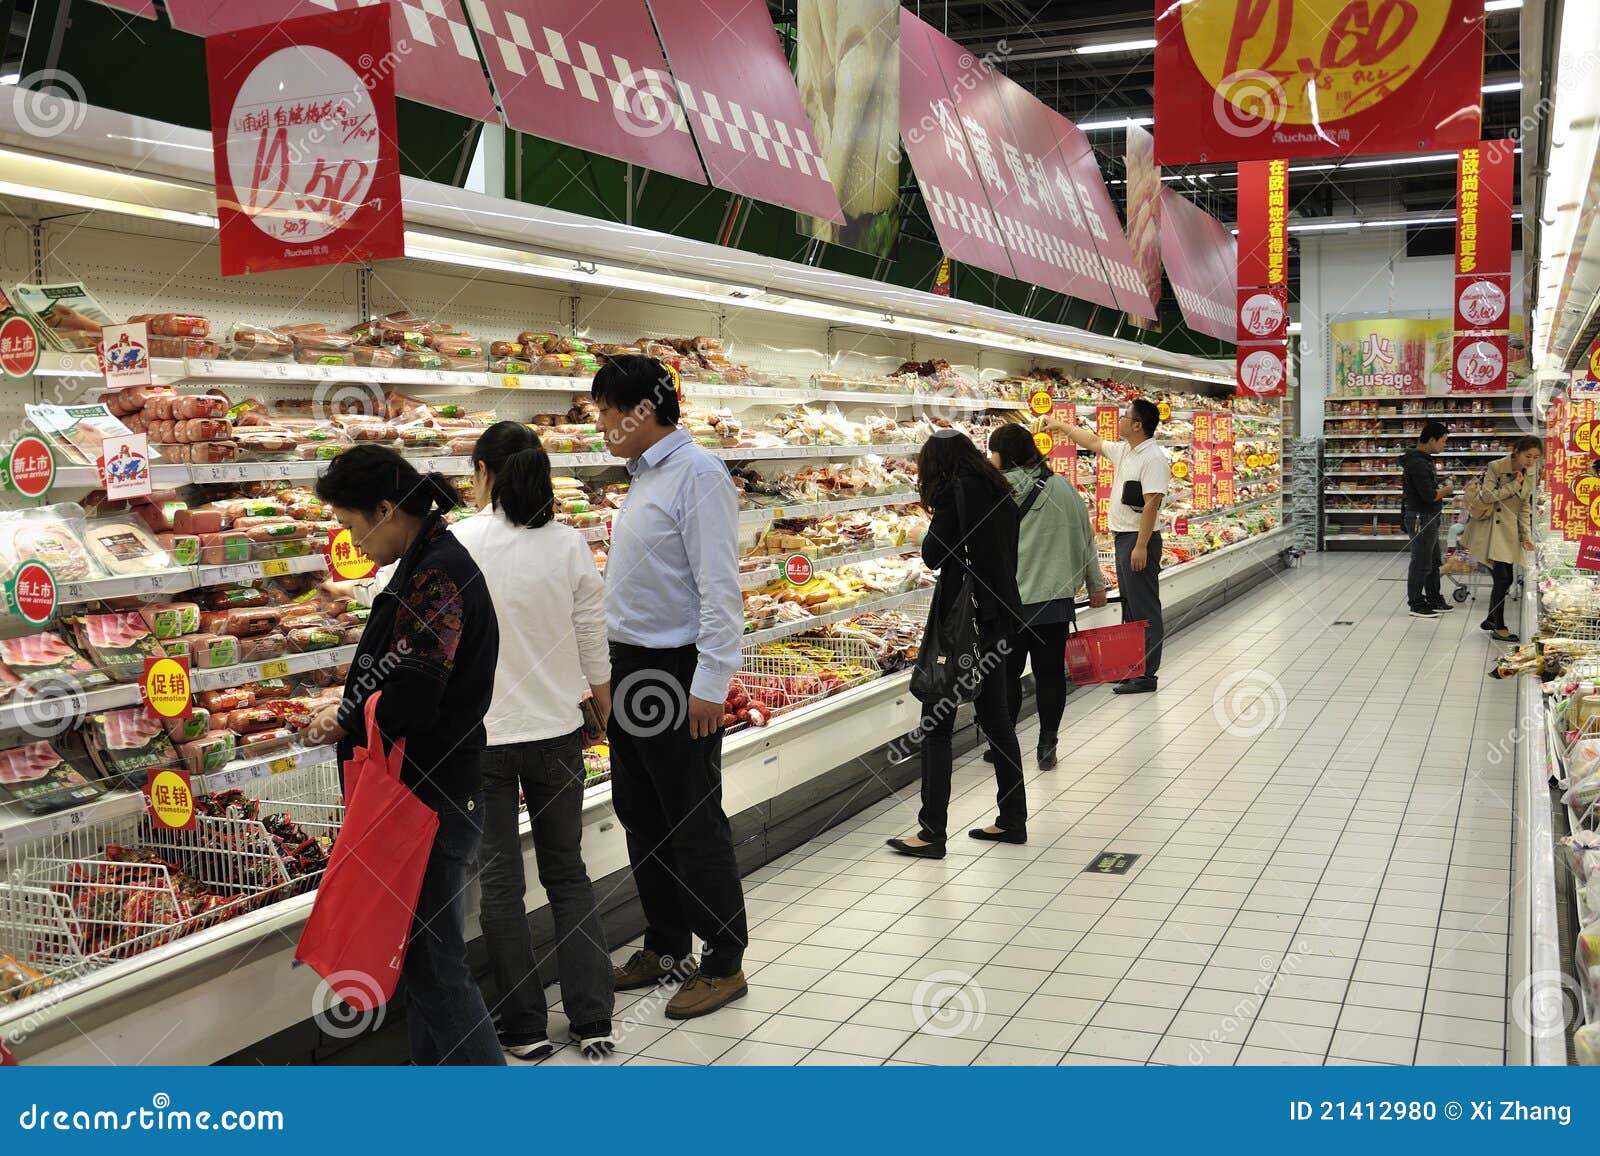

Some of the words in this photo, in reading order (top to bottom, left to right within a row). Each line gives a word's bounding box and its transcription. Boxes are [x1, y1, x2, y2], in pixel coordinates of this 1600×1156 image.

[1268, 160, 1285, 284] 在欧尚您省得更多
[1, 336, 33, 352] 新上市
[1347, 372, 1412, 389] Sausage
[14, 455, 48, 473] 新上市
[1564, 501, 1587, 540] 促销
[18, 581, 52, 598] 新上市
[151, 673, 185, 695] 促销
[152, 695, 187, 703] promotion
[156, 784, 188, 807] 促销
[157, 806, 190, 814] promotion
